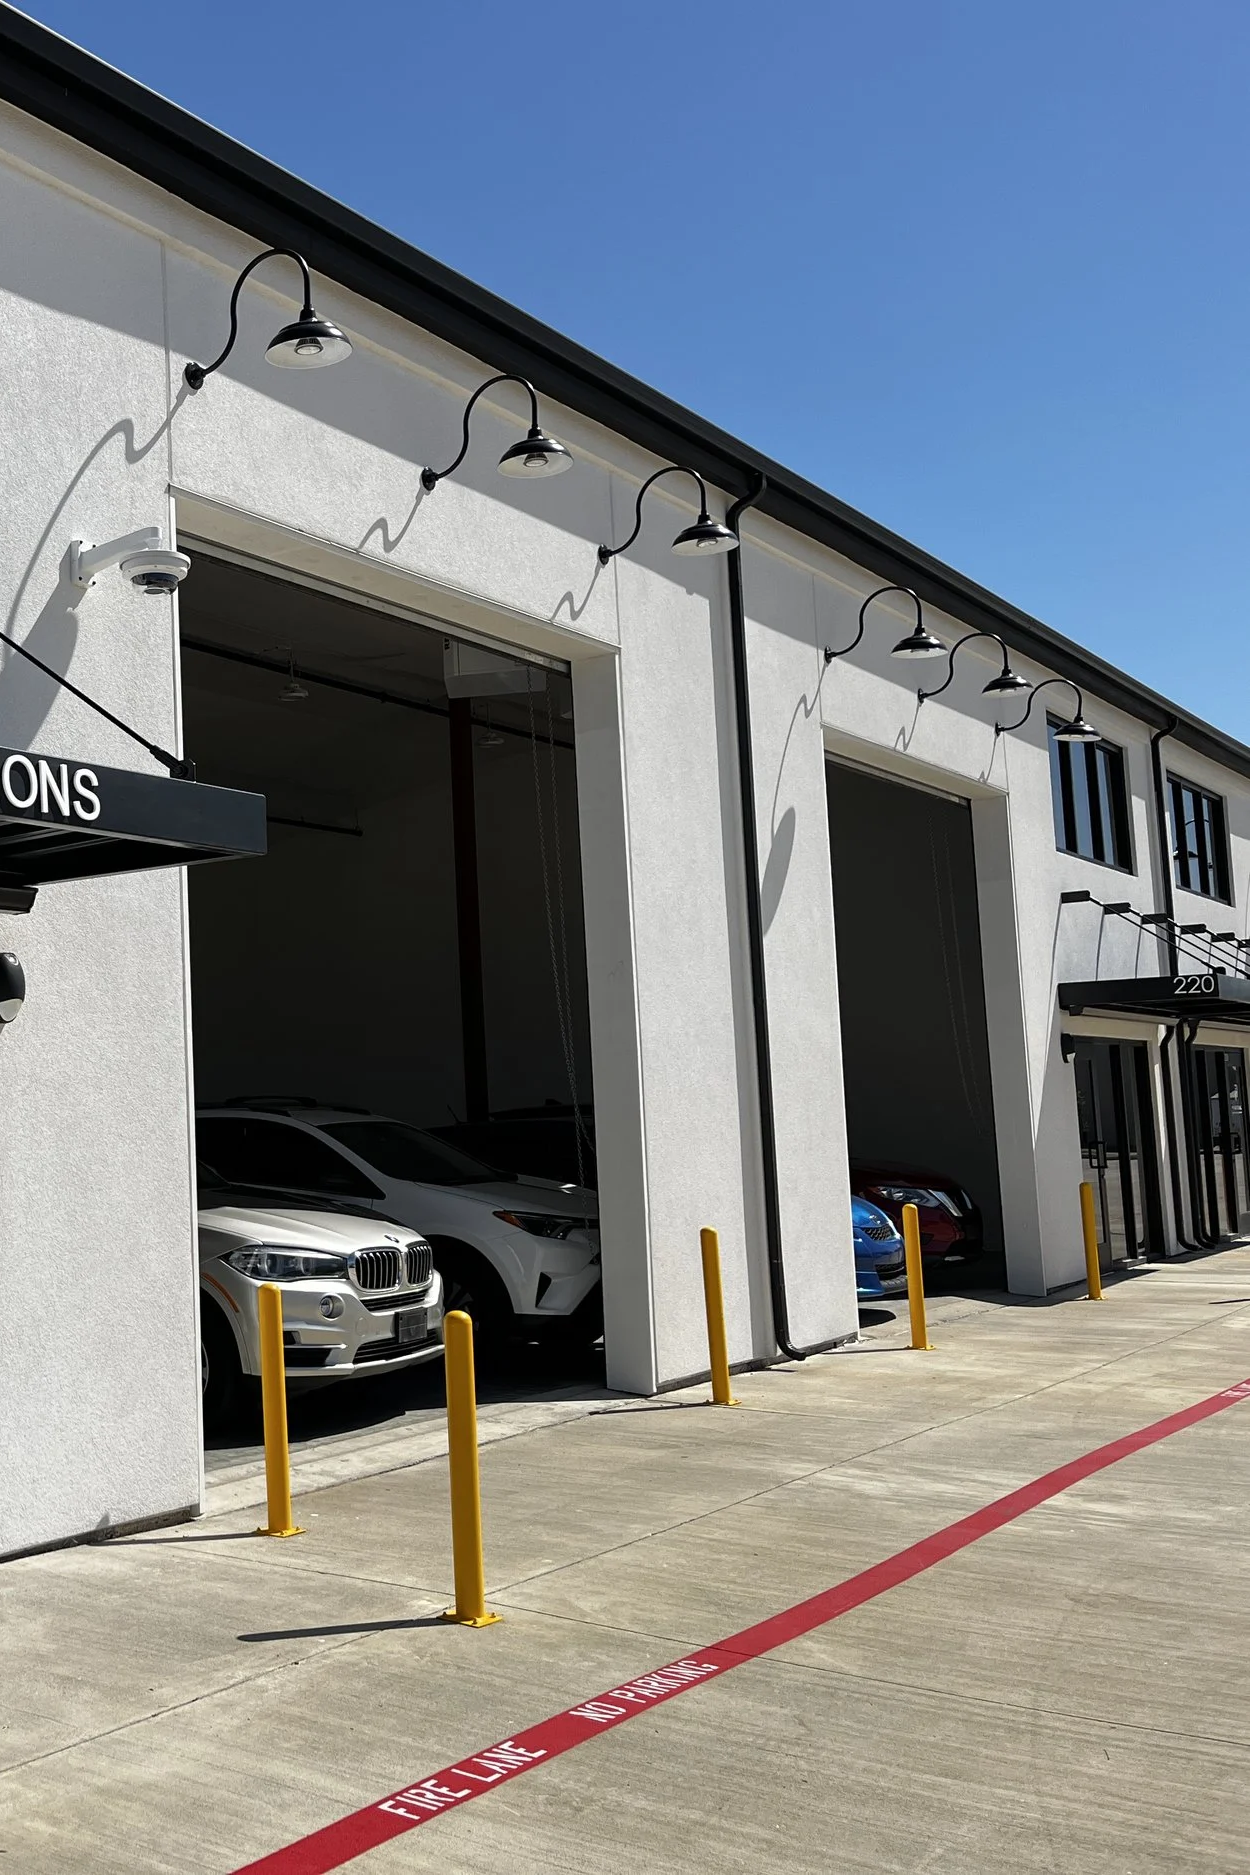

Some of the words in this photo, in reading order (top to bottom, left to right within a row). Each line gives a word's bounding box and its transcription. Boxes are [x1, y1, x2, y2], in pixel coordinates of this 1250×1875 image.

[1173, 975, 1215, 994] 220
[378, 1779, 472, 1820] FIRE
[450, 1740, 548, 1783] LANE
[569, 1701, 627, 1723] NO
[608, 1660, 719, 1704] PARKING
